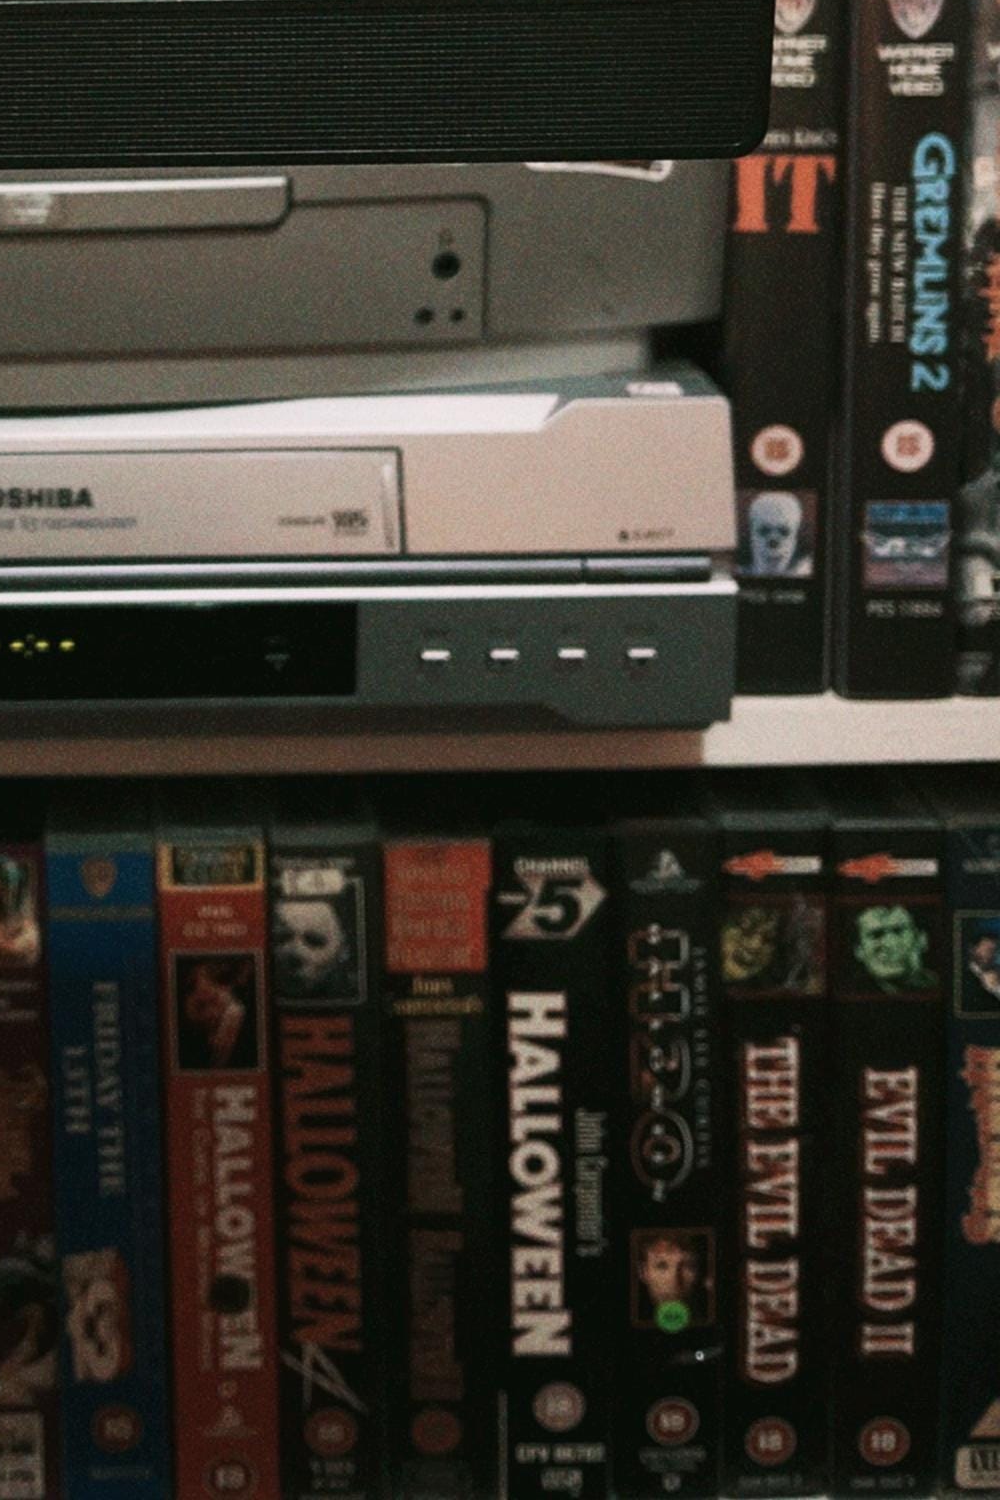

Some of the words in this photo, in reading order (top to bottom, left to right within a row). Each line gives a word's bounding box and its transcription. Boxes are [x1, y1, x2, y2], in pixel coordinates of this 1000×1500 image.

[732, 153, 837, 234] IT
[909, 132, 957, 356] GREMLINS
[910, 361, 951, 393] 2
[744, 1035, 800, 1129] THE
[863, 1066, 919, 1176] EVIL
[212, 1084, 265, 1370] HALLOWEN
[279, 1014, 362, 1352] HALLOWEEN
[505, 990, 572, 1357] HALLOWEEN
[745, 1138, 800, 1250] EVIL
[863, 1185, 918, 1312] DEAD
[746, 1258, 799, 1384] DEAD
[860, 1321, 916, 1357] II
